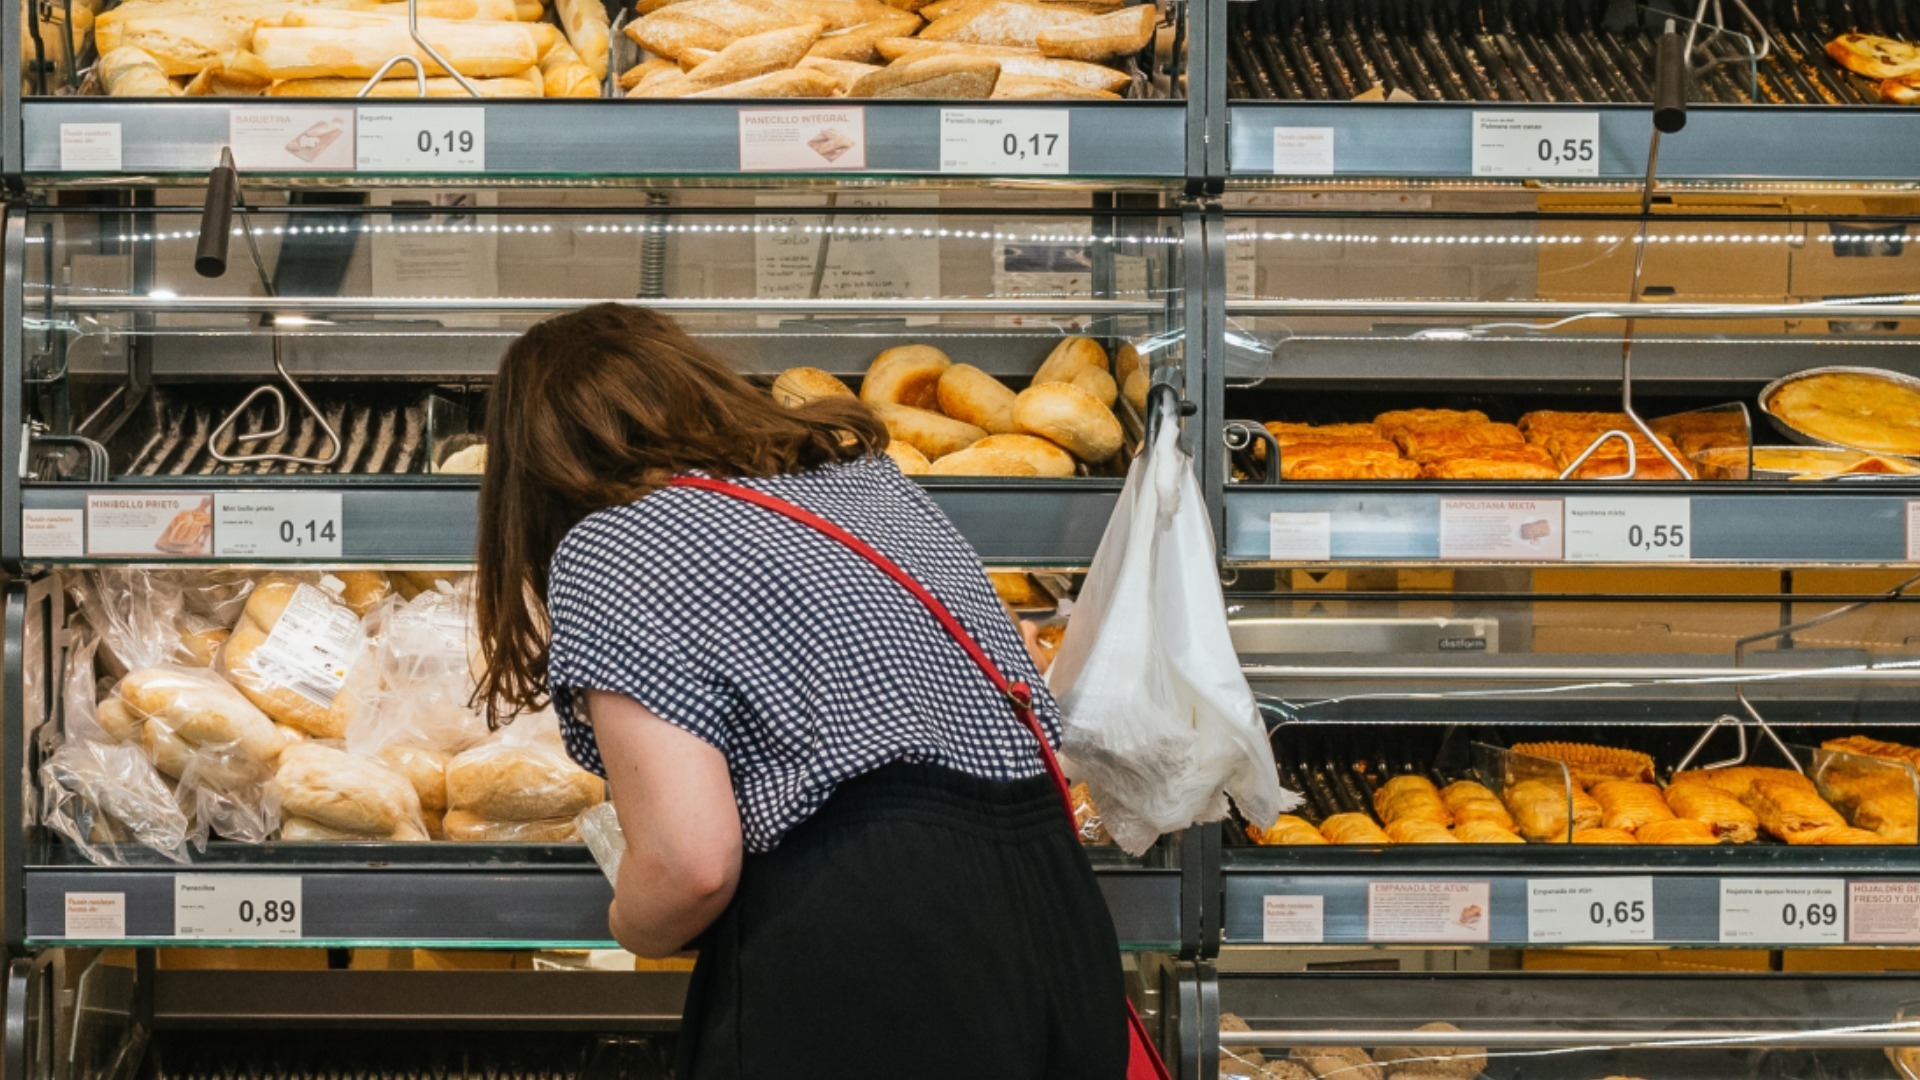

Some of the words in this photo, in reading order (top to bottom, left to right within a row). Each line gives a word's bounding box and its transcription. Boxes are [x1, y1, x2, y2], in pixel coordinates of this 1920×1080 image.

[235, 115, 292, 124] BAGUETINA
[745, 115, 799, 124] PANECILLO
[801, 114, 849, 123] INTEGRAL
[417, 130, 474, 157] 0,19
[1003, 133, 1059, 160] 0,17
[1538, 139, 1594, 166] 0,55
[92, 500, 143, 508] MINIBOLLO
[146, 500, 180, 508] PRIETO
[1508, 502, 1536, 510] MIXTA
[280, 520, 336, 546] 0,14
[1628, 525, 1684, 551] 0,55
[1375, 884, 1426, 892] EMPANADA
[1429, 884, 1441, 892] DE
[1854, 885, 1904, 893] HOJALDRE
[1854, 895, 1892, 903] FRESCO
[239, 900, 296, 927] 0,89
[1590, 901, 1645, 927] 0,65
[1782, 903, 1837, 930] 0,69
